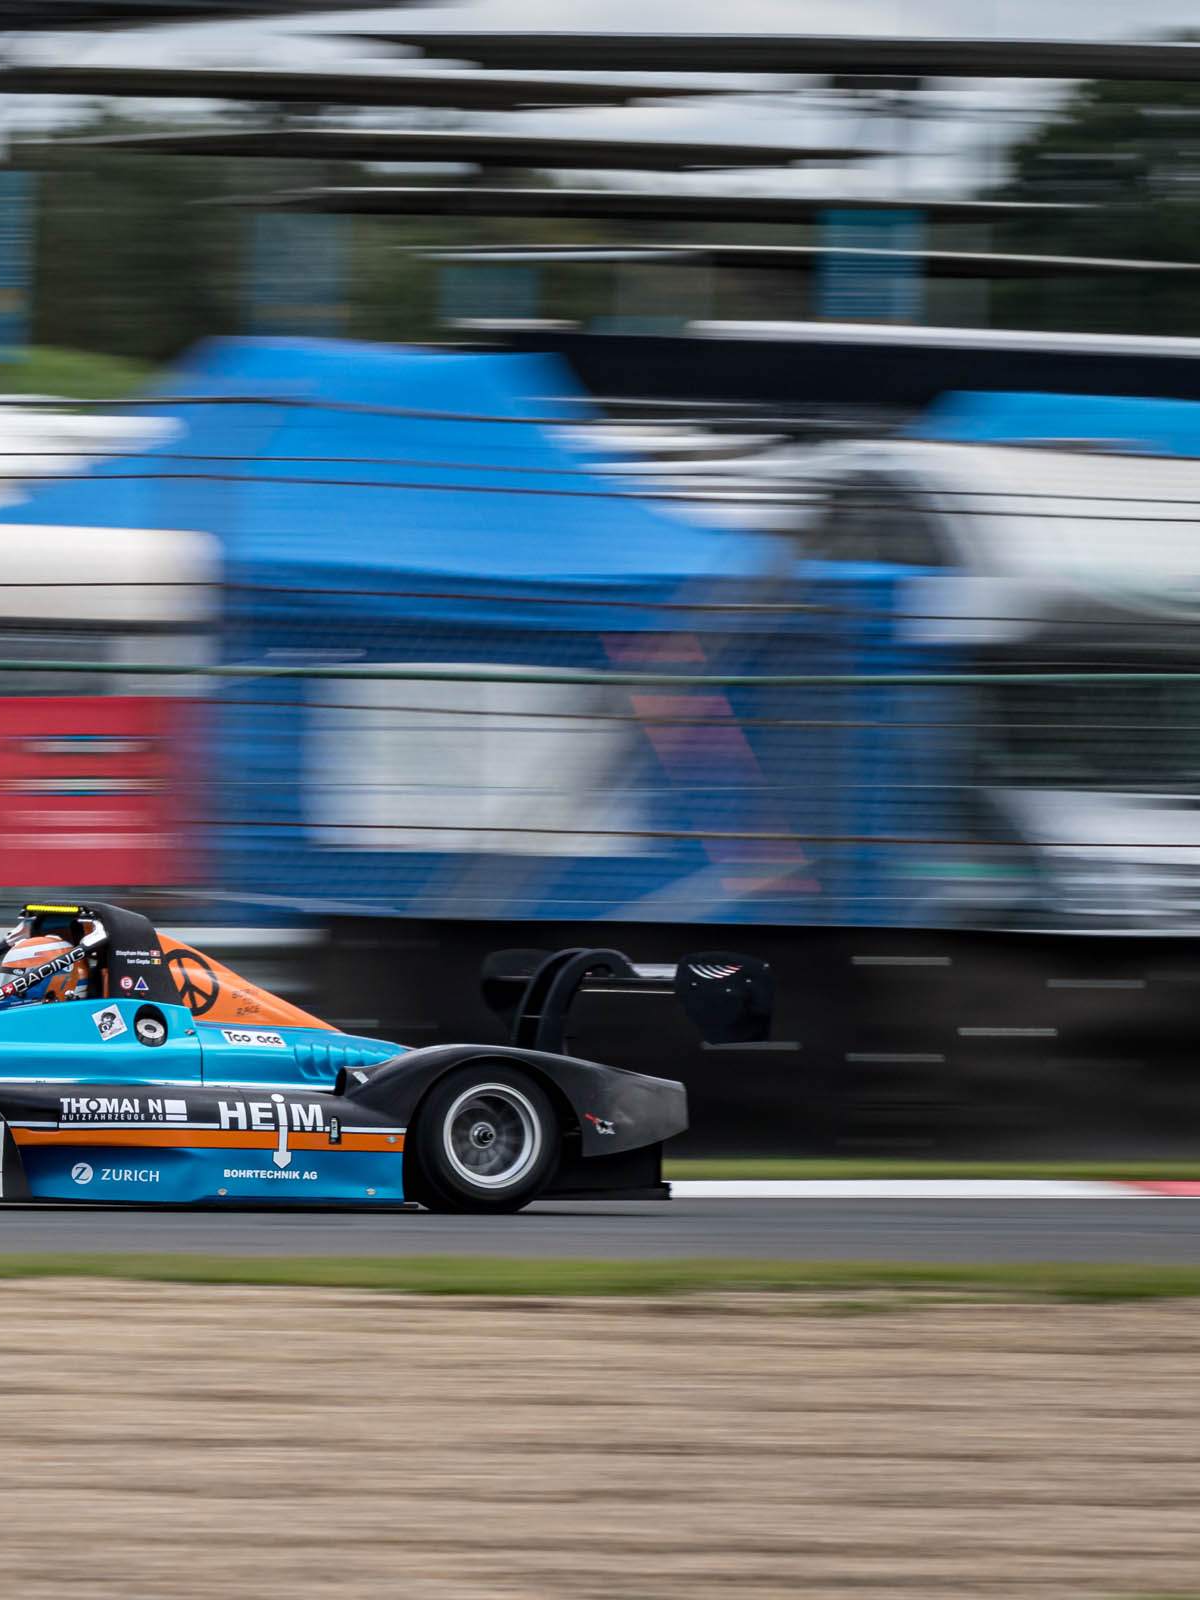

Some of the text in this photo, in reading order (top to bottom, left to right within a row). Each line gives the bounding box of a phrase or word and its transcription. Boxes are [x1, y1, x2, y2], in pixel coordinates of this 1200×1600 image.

[12, 947, 86, 993] RACING
[61, 1113, 145, 1121] NUTZFAHRZEUGE
[101, 1168, 160, 1183] ZURICH
[223, 1168, 318, 1180] BOHRTECHNIK AG
